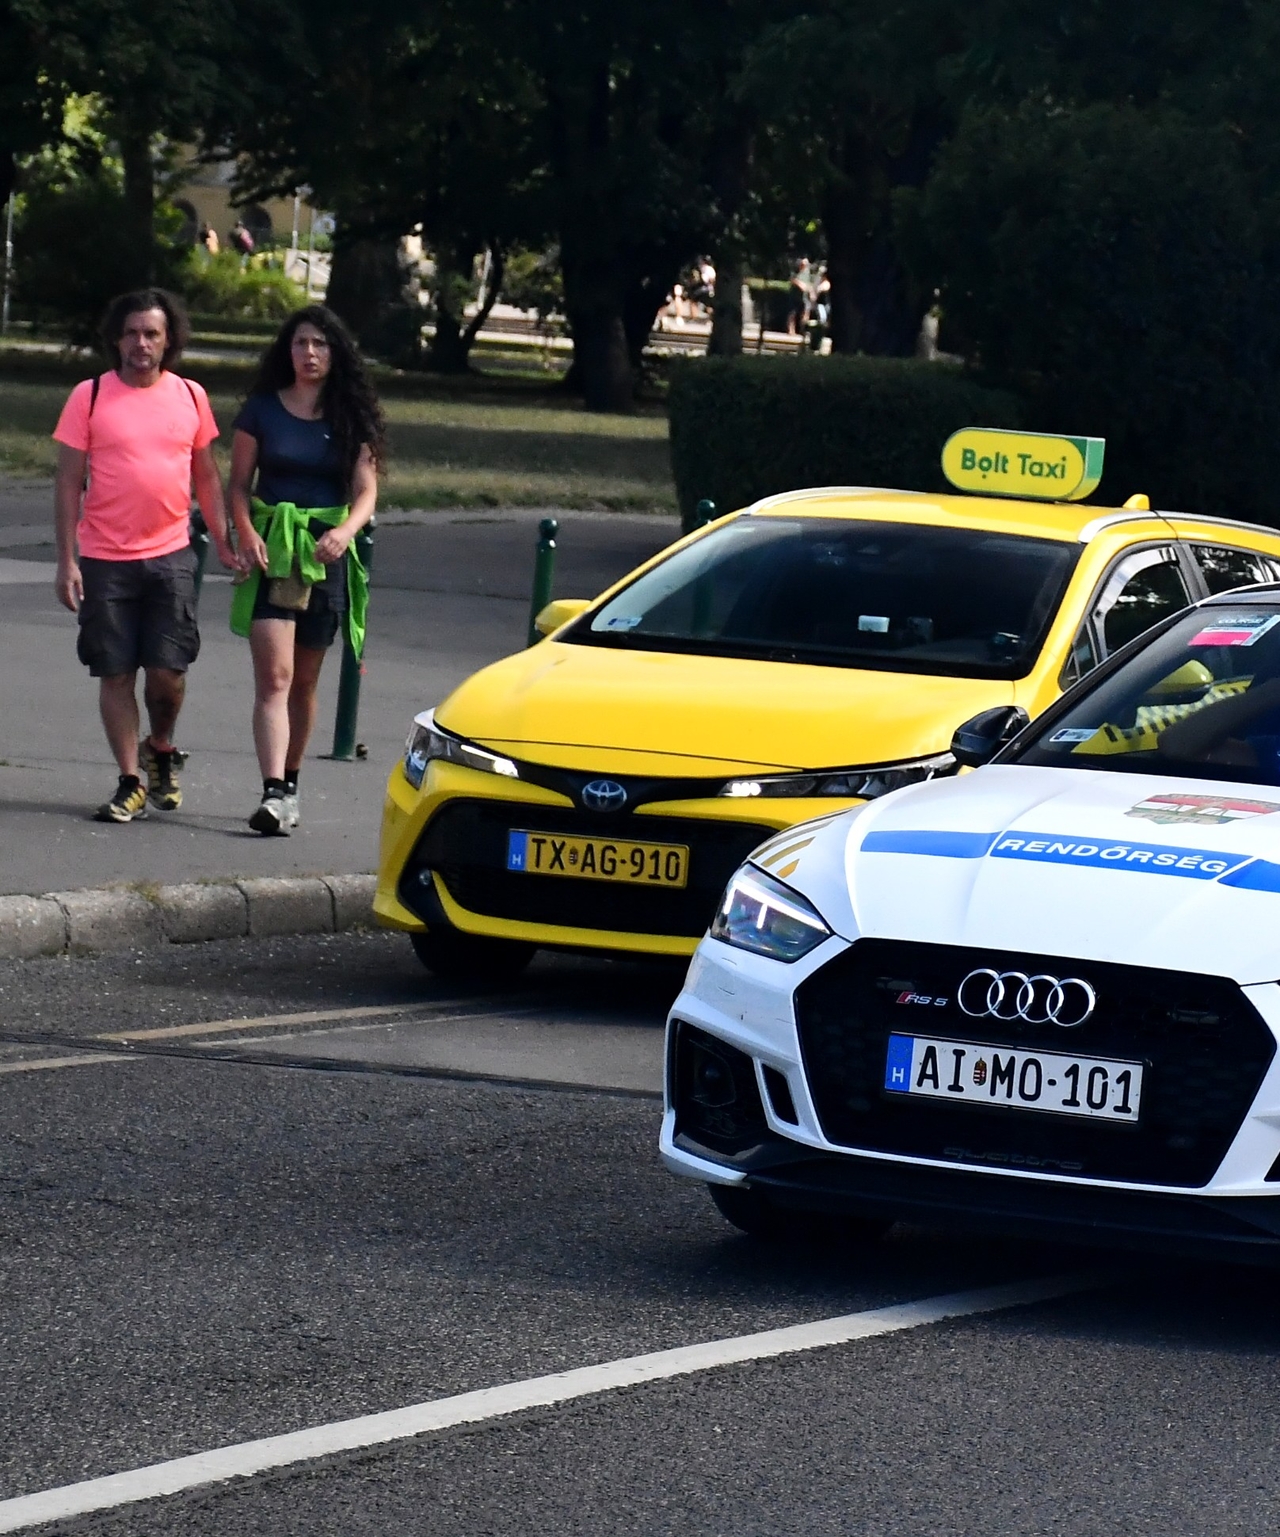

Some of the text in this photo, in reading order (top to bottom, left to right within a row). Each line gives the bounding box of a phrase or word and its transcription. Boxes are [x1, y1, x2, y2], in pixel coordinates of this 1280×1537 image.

[961, 448, 1067, 479] Bolt Taxi
[512, 854, 522, 865] H
[997, 838, 1229, 874] RENDŐRSÉG
[891, 1066, 904, 1083] H
